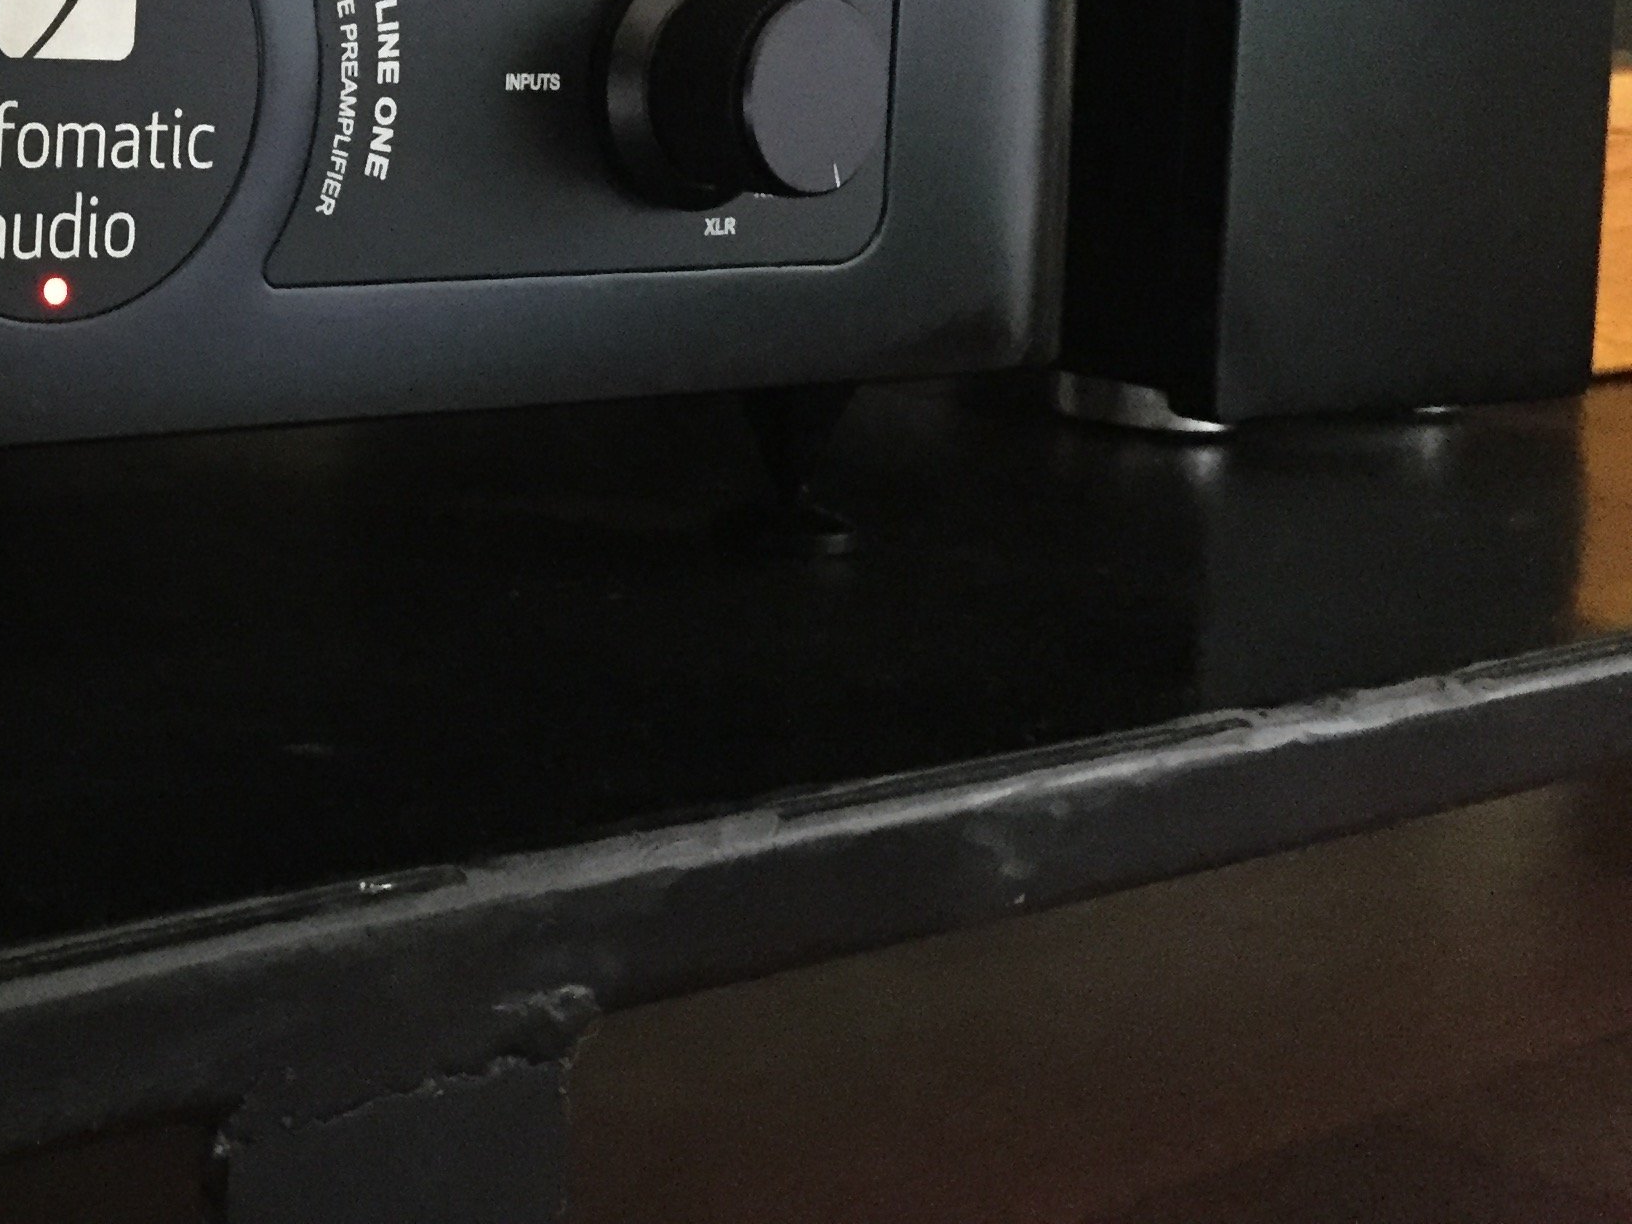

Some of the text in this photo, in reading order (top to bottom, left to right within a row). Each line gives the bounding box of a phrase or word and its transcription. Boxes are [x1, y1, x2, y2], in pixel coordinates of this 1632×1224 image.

[504, 72, 562, 92] INPUTS
[315, 22, 359, 217] PREAMPLIFIER
[363, 96, 398, 181] ONE
[703, 216, 737, 237] XLR
